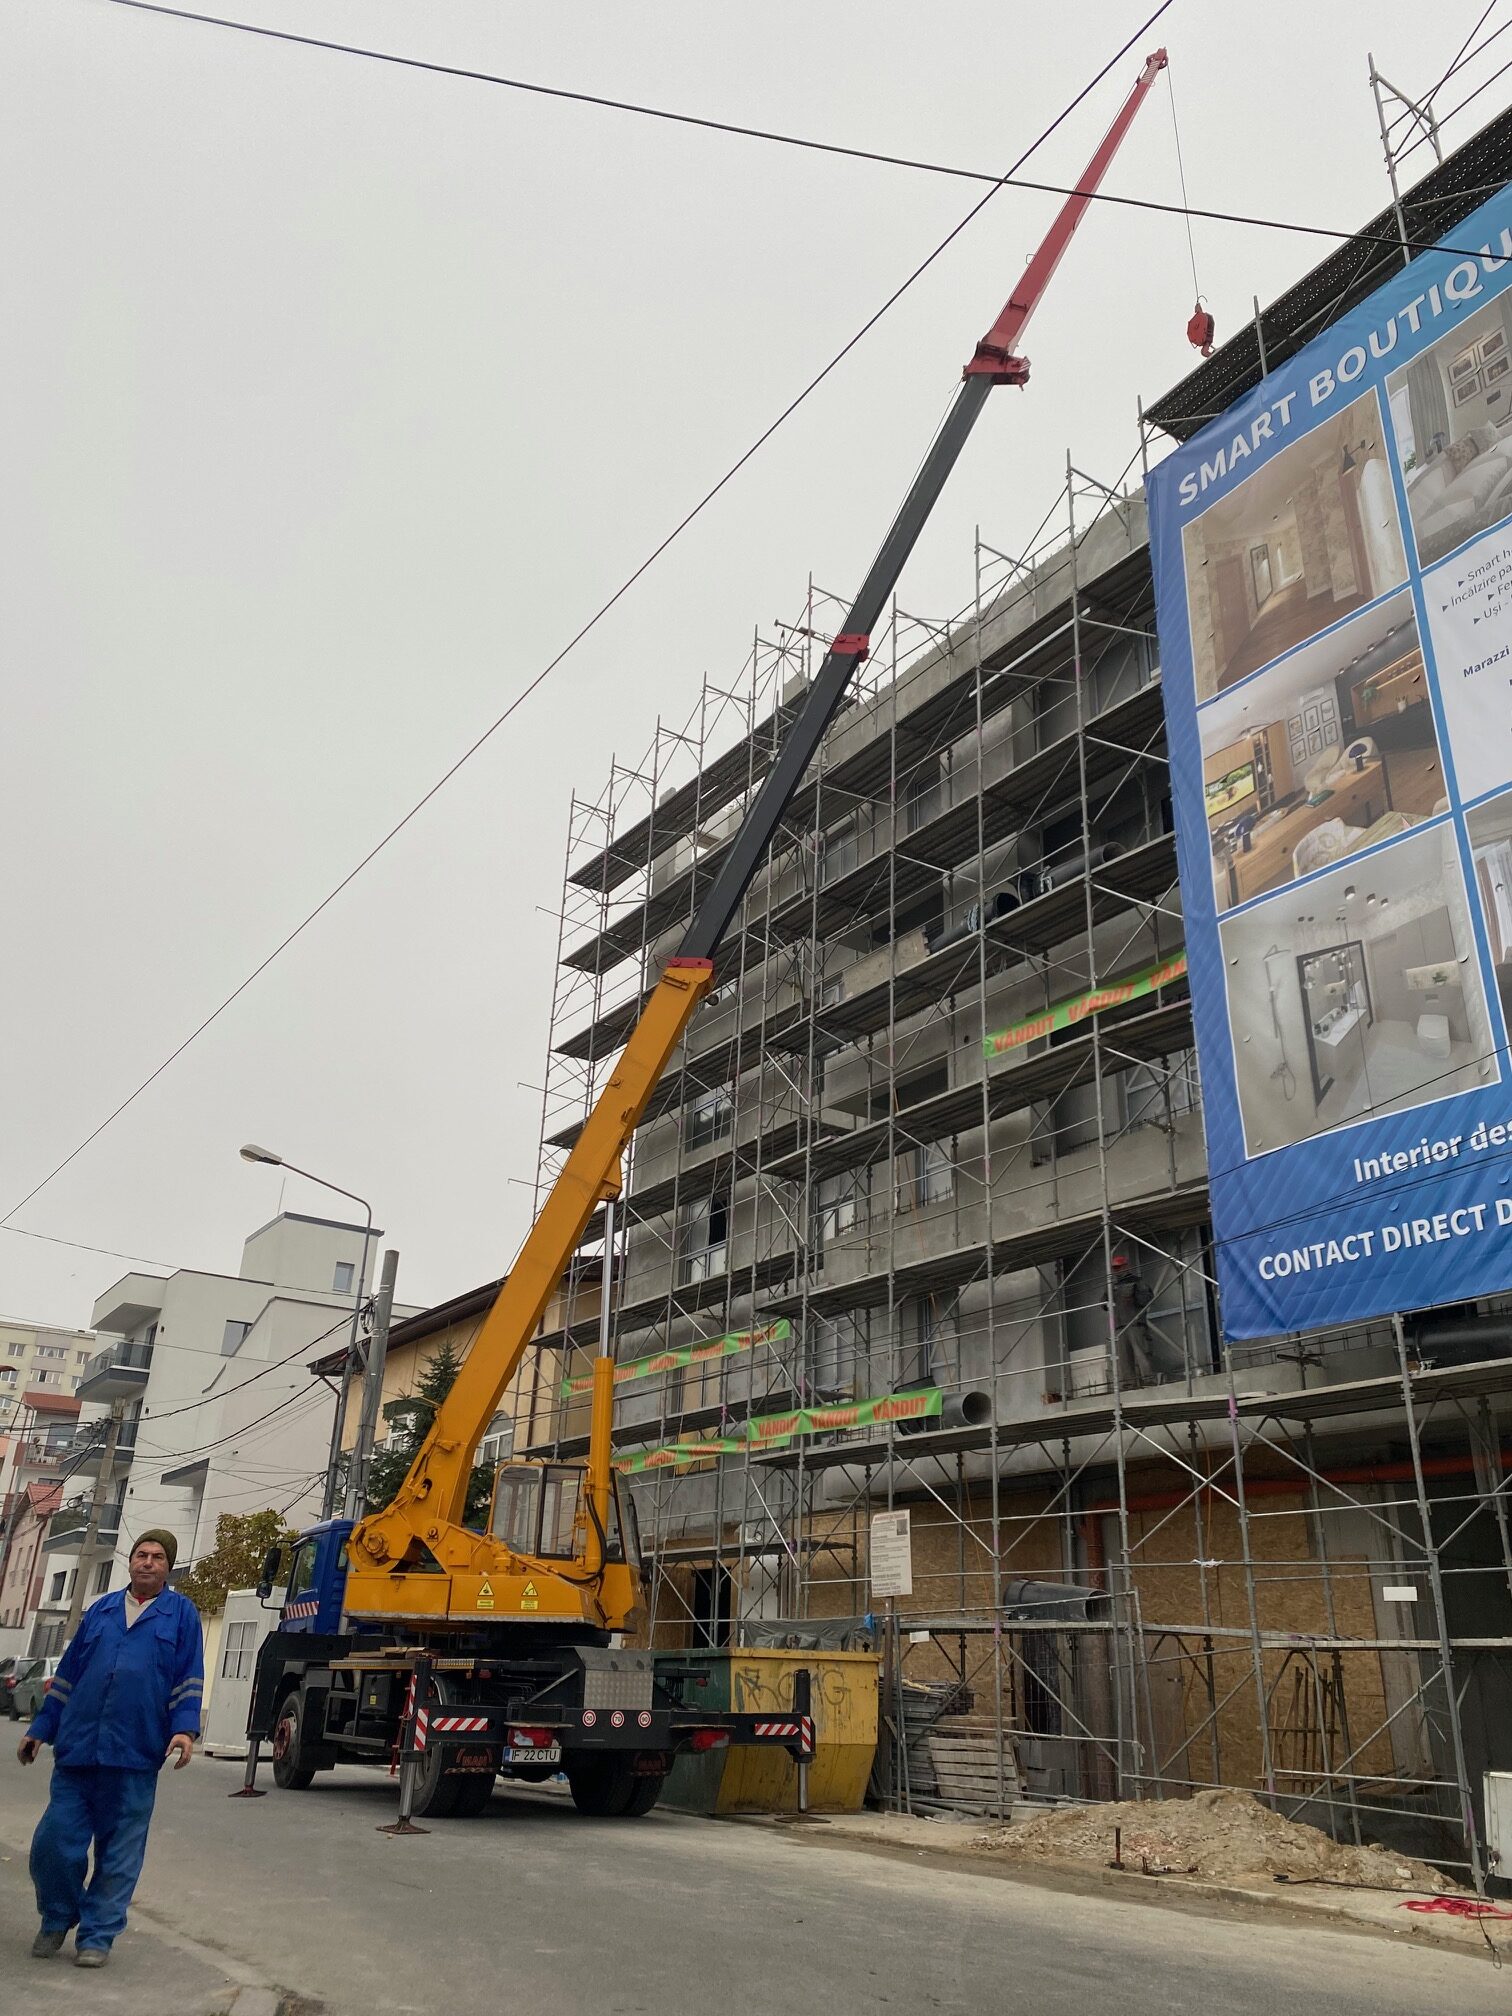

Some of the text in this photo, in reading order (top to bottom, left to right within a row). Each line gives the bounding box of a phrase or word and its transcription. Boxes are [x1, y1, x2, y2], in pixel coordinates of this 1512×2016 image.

[1179, 228, 1512, 506] SMART BOUTIQU
[1467, 554, 1501, 582] Smart
[1497, 580, 1512, 595] Fe
[1463, 645, 1510, 678] Marazzi
[1354, 1135, 1463, 1183] Interior
[1258, 1231, 1375, 1281] CONTACT
[1381, 1203, 1487, 1253] DIRECT
[511, 1749, 557, 1761] IF 22 CTU
